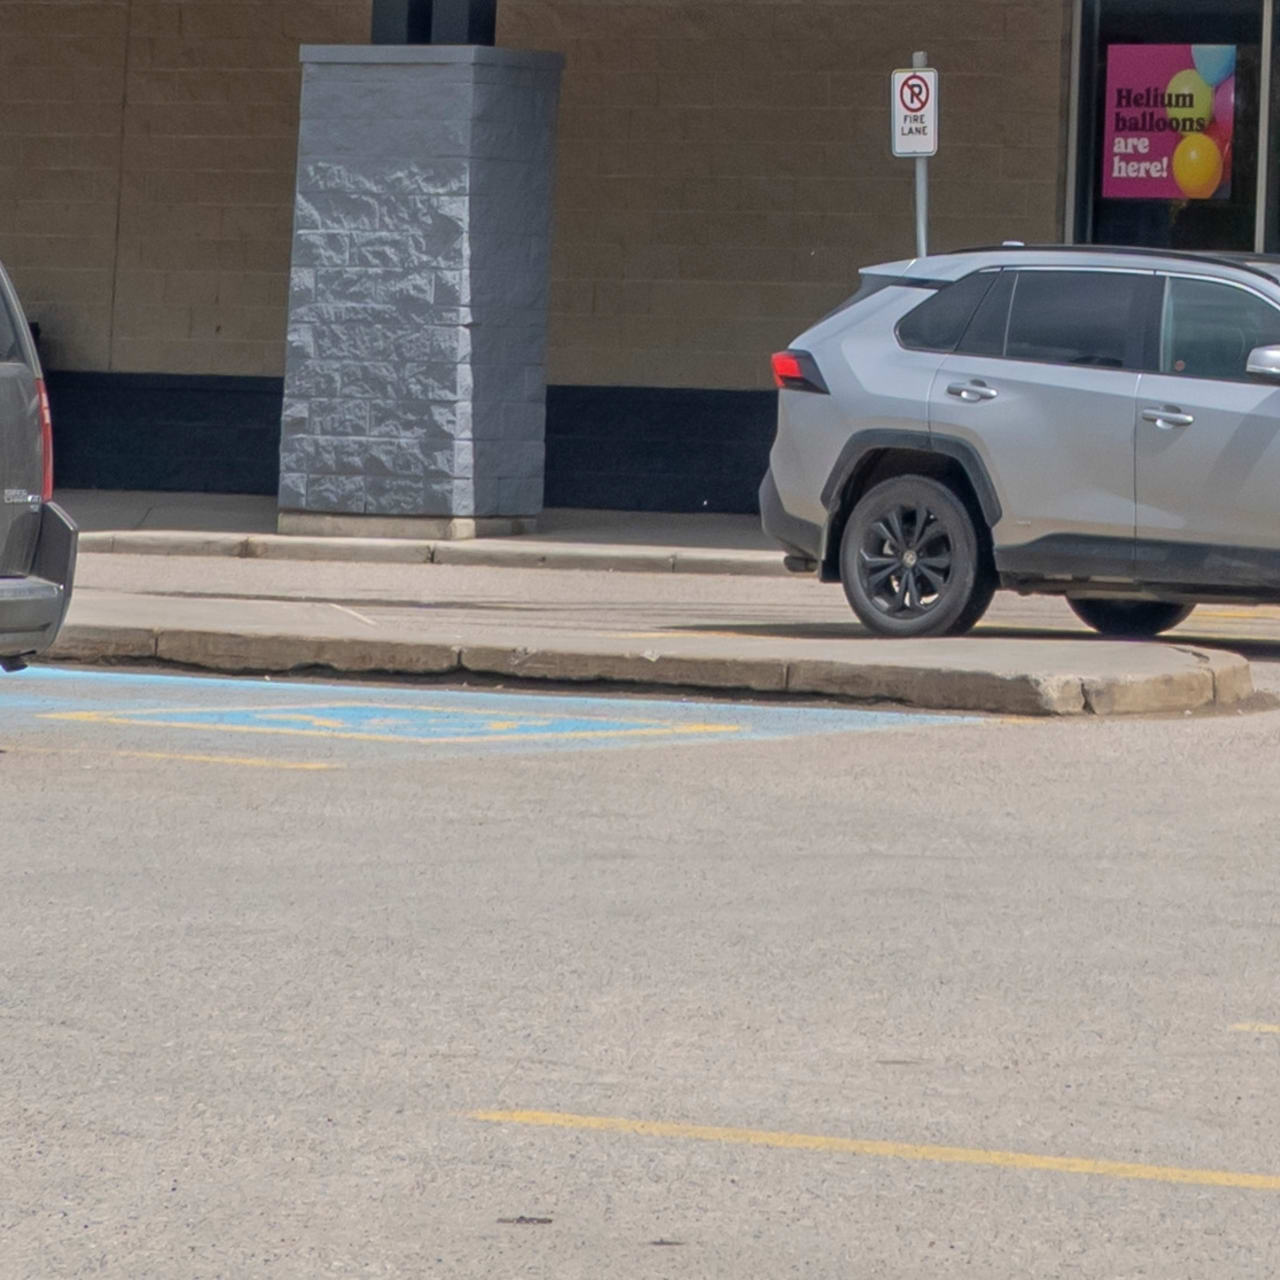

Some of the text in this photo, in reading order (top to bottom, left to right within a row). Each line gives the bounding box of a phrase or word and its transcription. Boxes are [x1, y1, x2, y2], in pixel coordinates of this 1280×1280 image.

[1114, 88, 1194, 109] Helium
[903, 114, 926, 124] FIRE
[1114, 112, 1206, 133] balloons
[900, 126, 928, 136] LANE
[1112, 137, 1149, 154] are
[1111, 156, 1169, 178] here!
